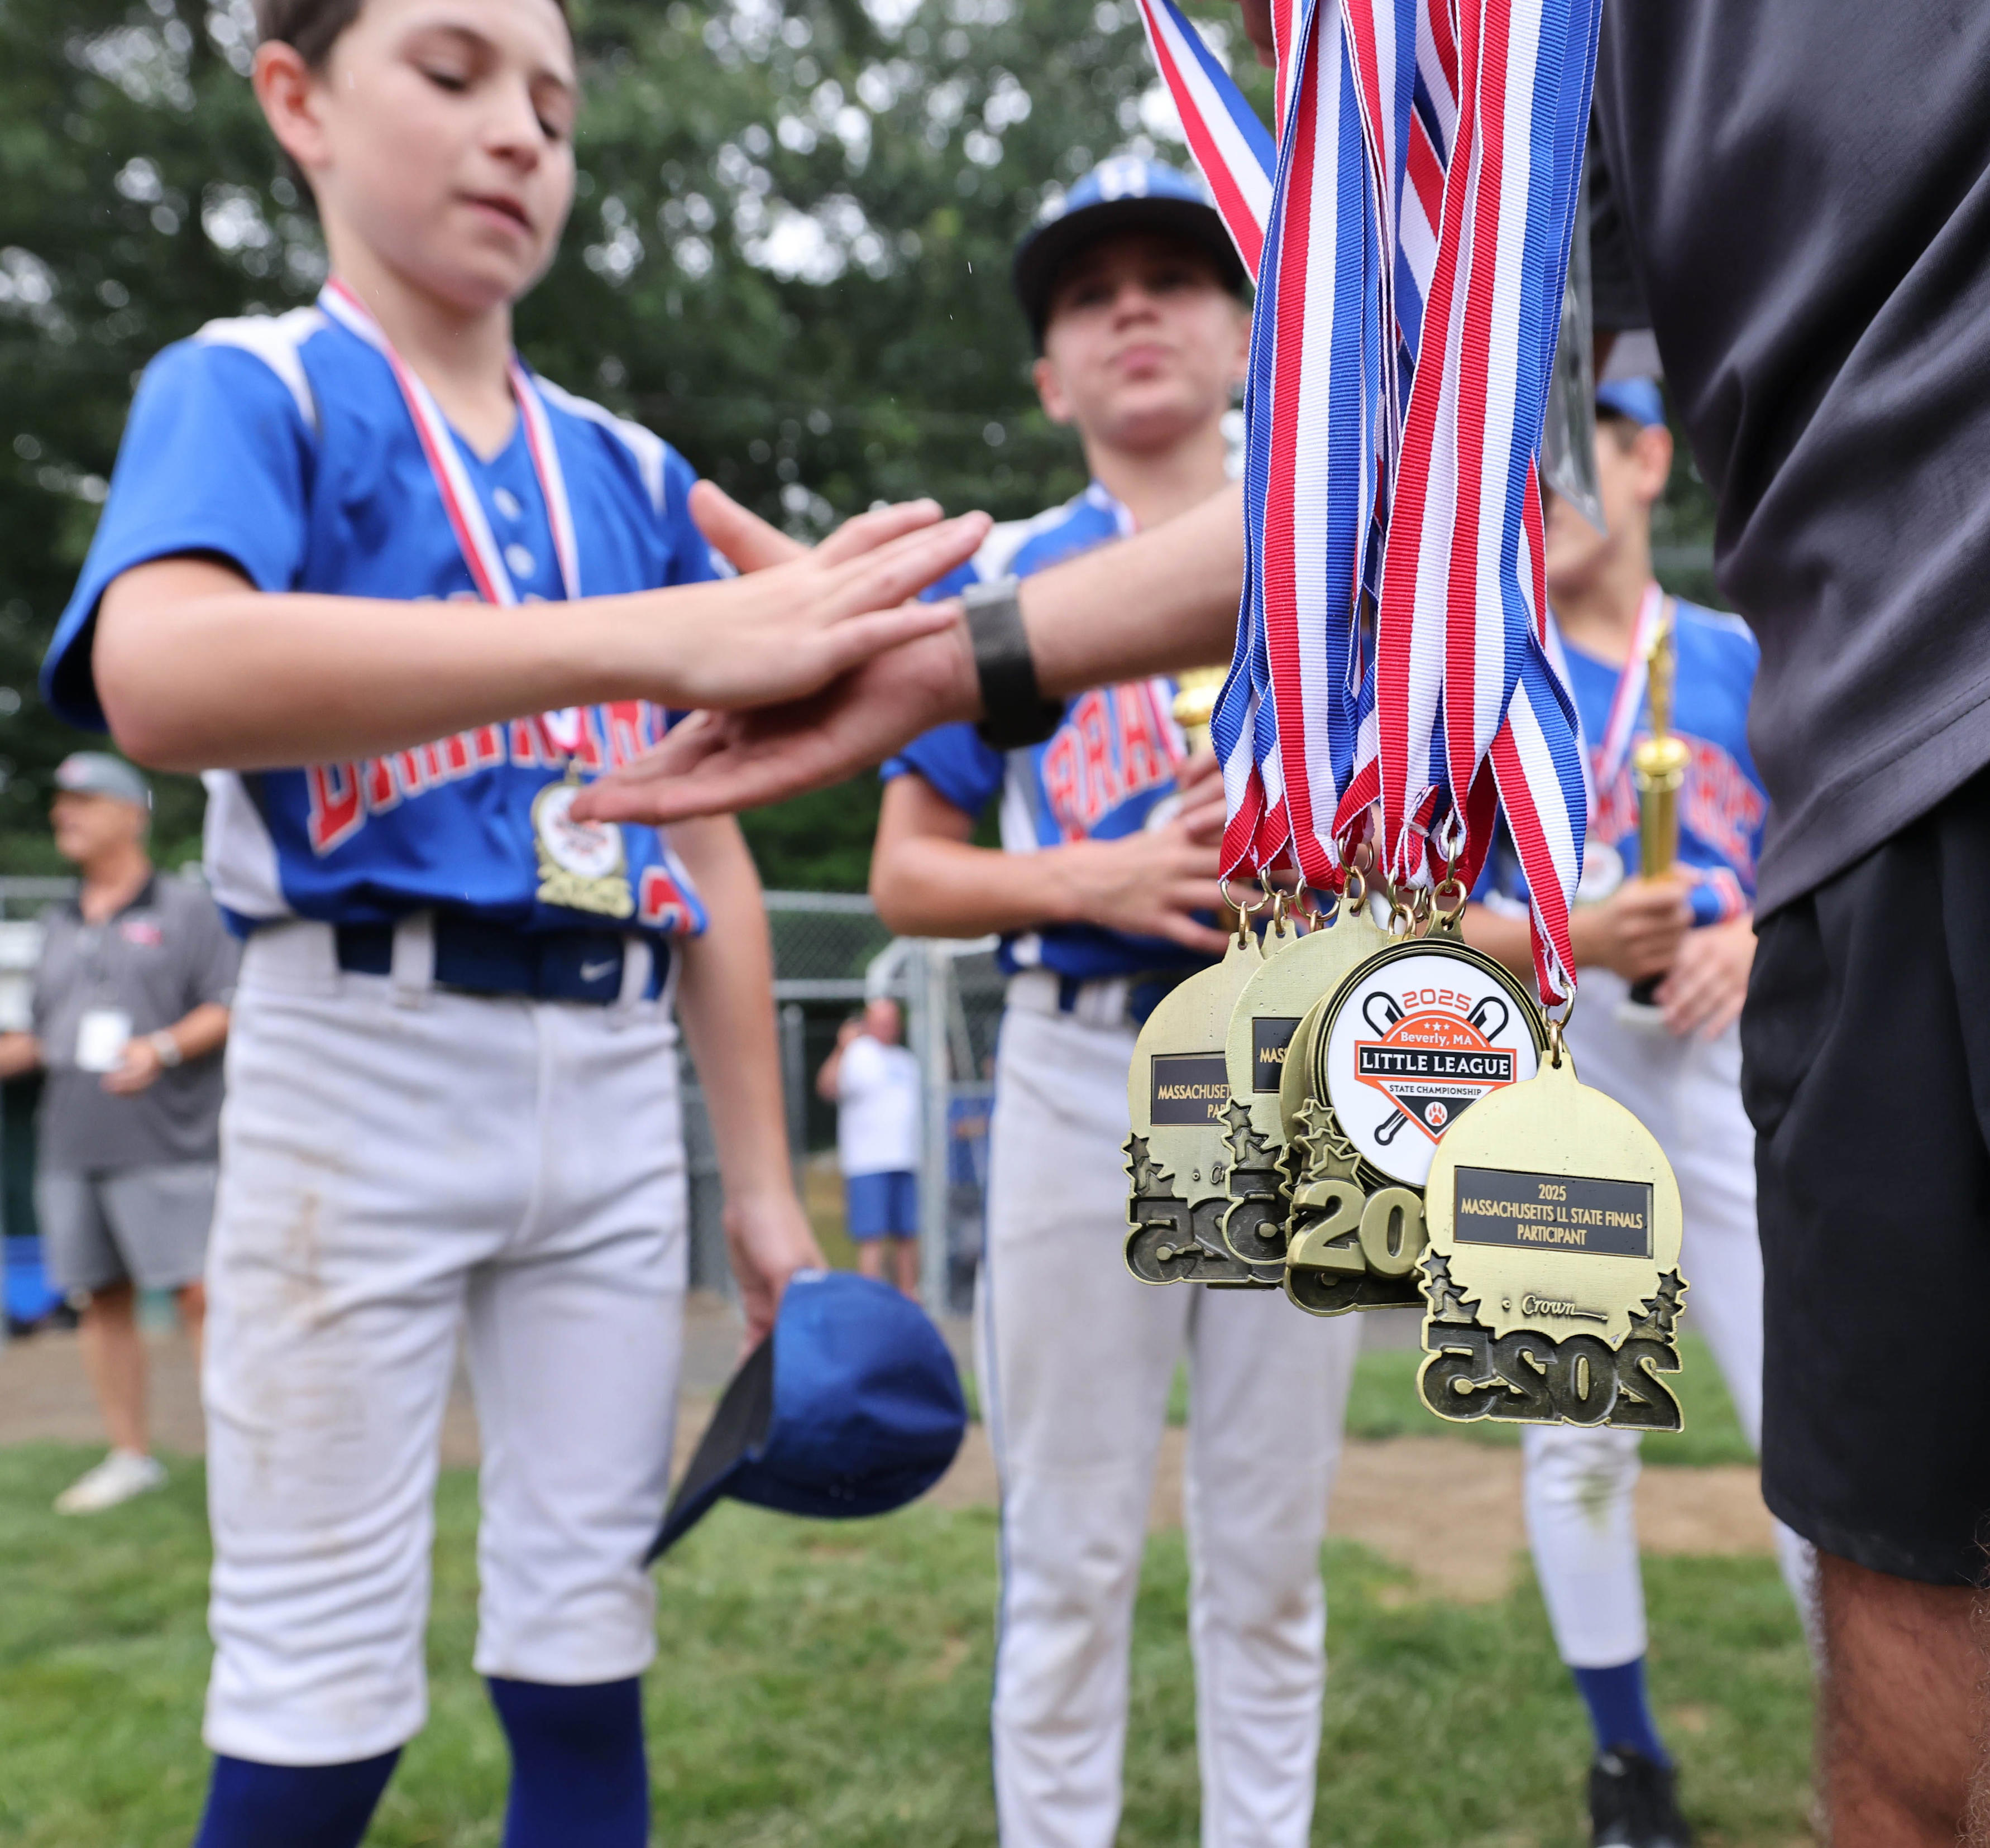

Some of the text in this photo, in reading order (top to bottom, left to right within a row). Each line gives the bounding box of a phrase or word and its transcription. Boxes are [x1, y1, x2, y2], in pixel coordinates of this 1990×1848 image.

[1402, 988, 1472, 1012] 2025
[1400, 1031, 1473, 1047] Beverly, MA
[1362, 1052, 1509, 1075] LITTLE LEAGUE
[1389, 1084, 1482, 1097] STATE CHAMPIONSHIP
[1538, 1183, 1567, 1201] 2025
[1461, 1198, 1643, 1230] MASSACHUSETTS LL STATE FINALS
[1517, 1224, 1587, 1246] PARTICIPANT
[1522, 1295, 1577, 1316] Crown
